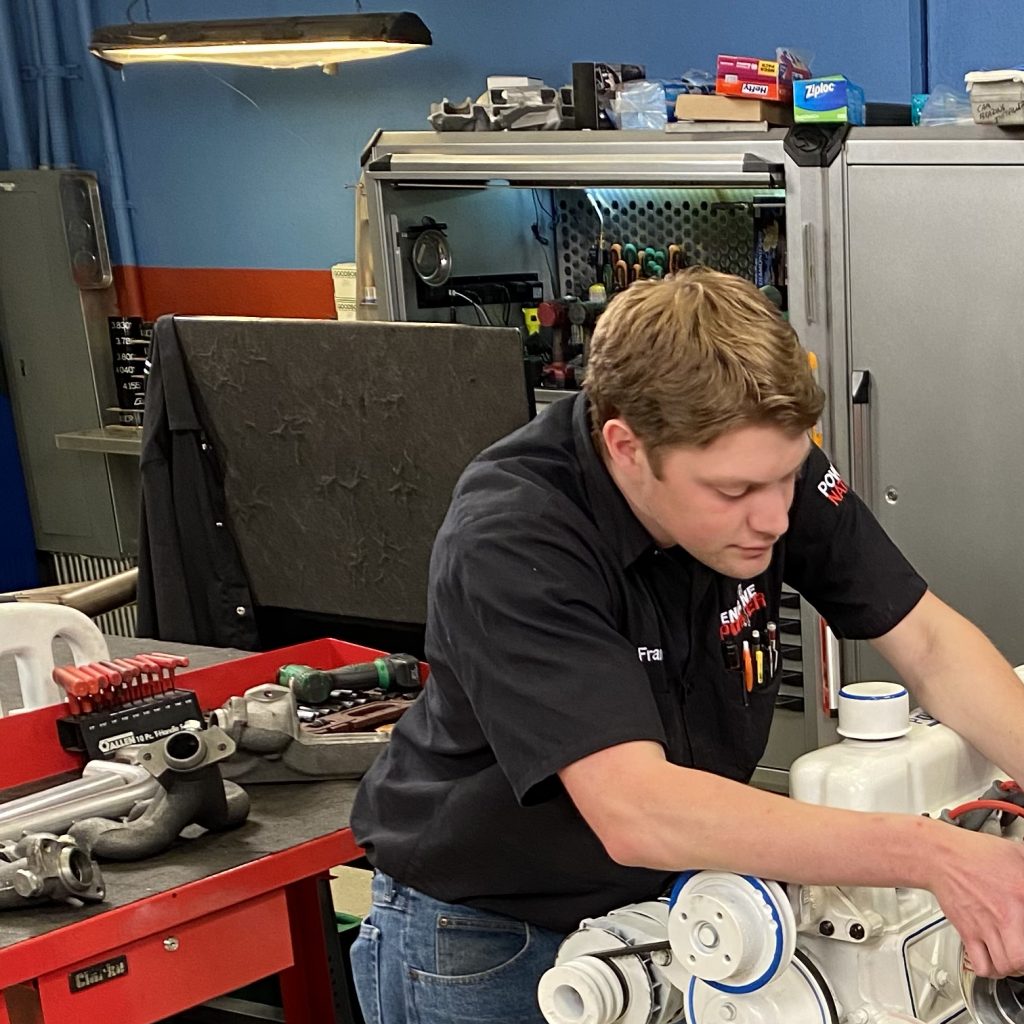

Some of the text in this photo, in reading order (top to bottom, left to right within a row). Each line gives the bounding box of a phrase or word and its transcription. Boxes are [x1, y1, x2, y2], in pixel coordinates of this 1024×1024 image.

[743, 83, 768, 94] Hefty
[805, 82, 836, 99] Ziploc
[108, 735, 137, 751] ALLEN
